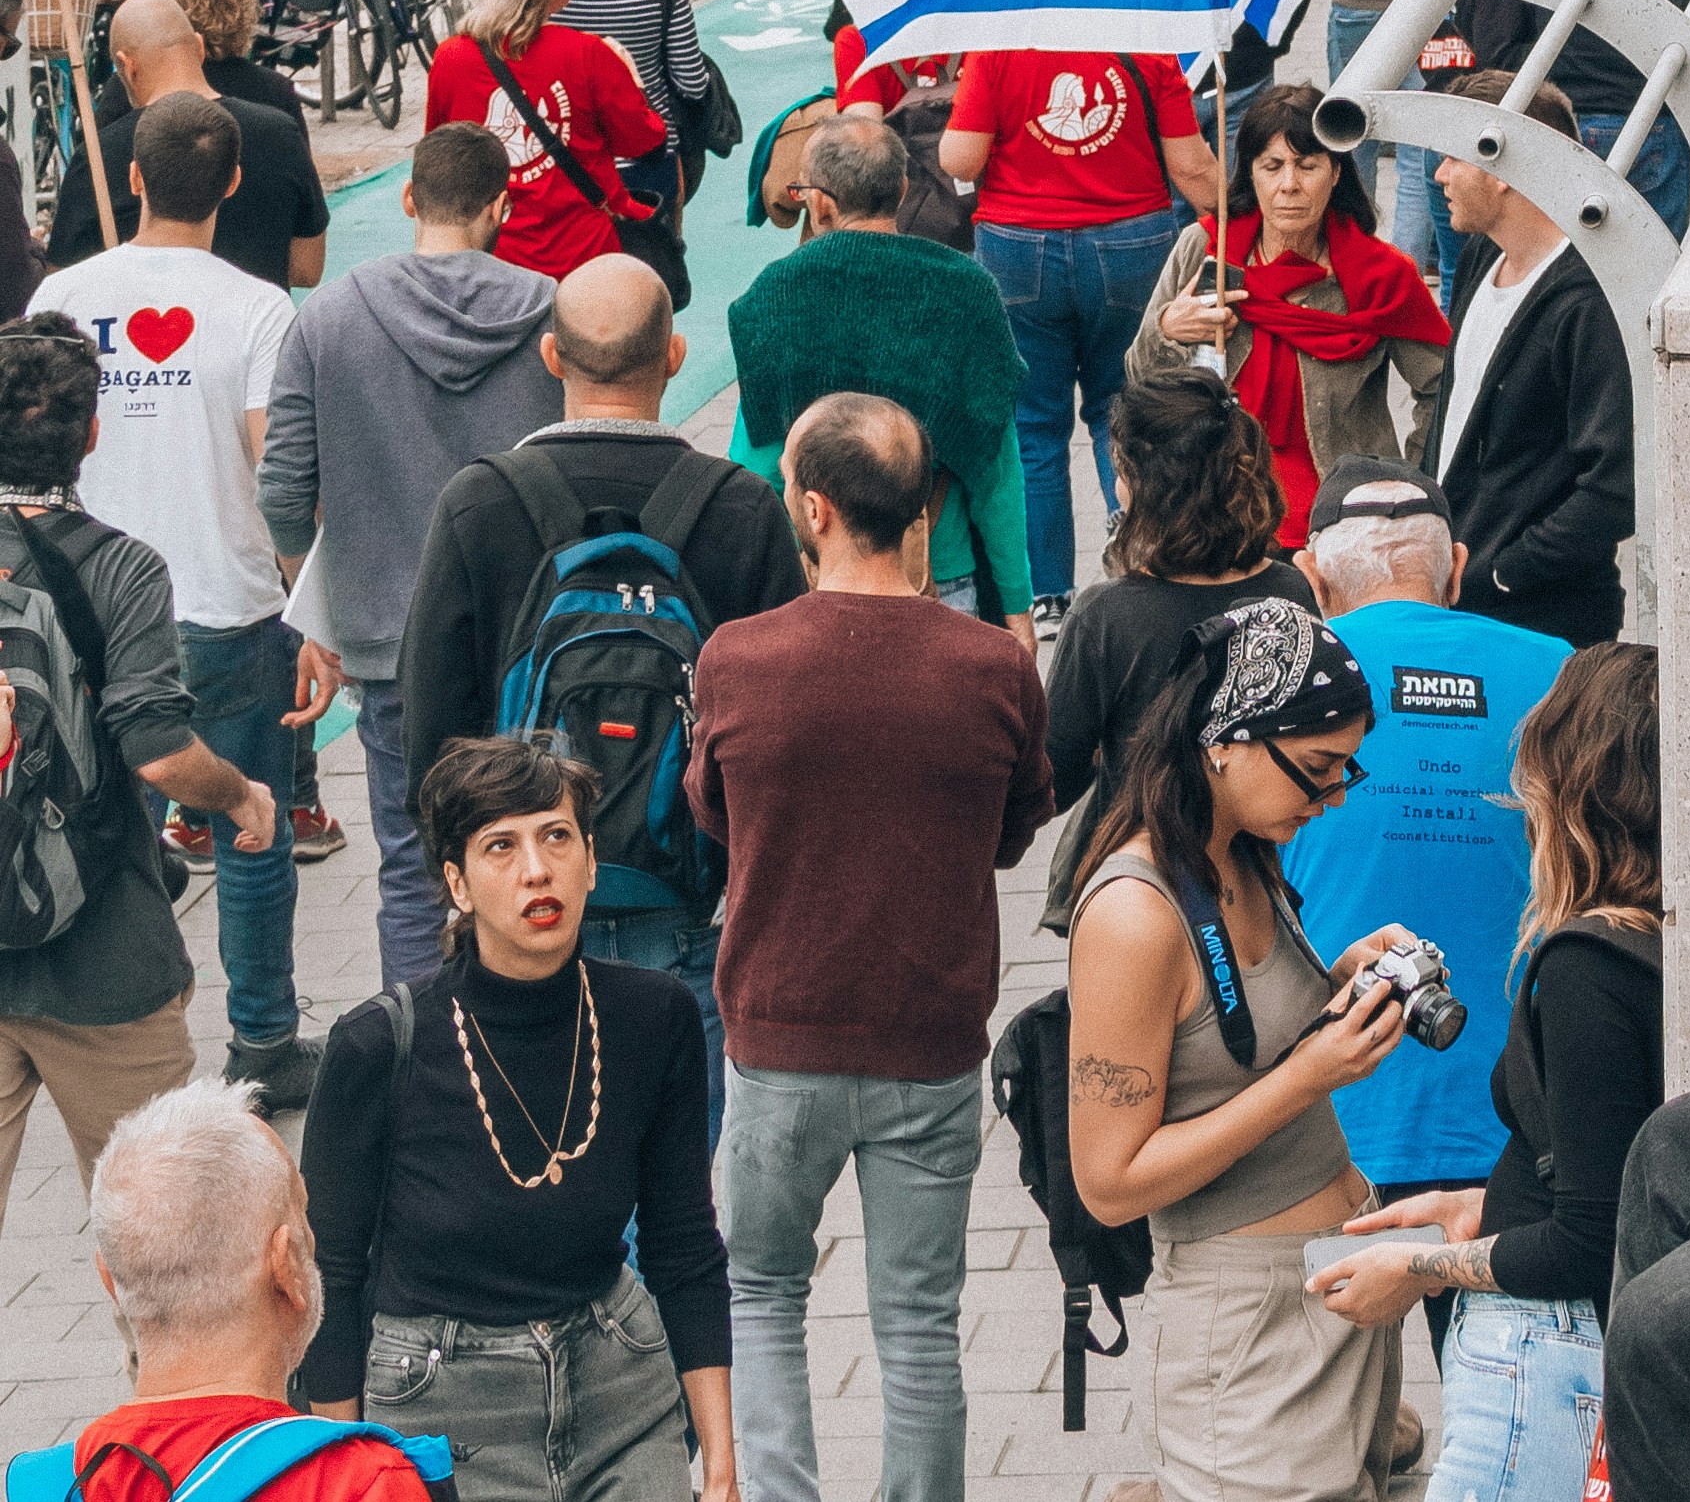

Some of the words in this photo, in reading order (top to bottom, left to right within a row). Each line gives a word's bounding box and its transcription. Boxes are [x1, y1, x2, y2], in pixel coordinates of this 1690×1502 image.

[91, 317, 117, 354] I
[1402, 675, 1476, 697] מחאת
[1402, 695, 1477, 709] ההייטקיסטים
[1418, 759, 1462, 774] Undo
[1402, 805, 1478, 821] Install
[1201, 924, 1238, 1015] MINOLTA
